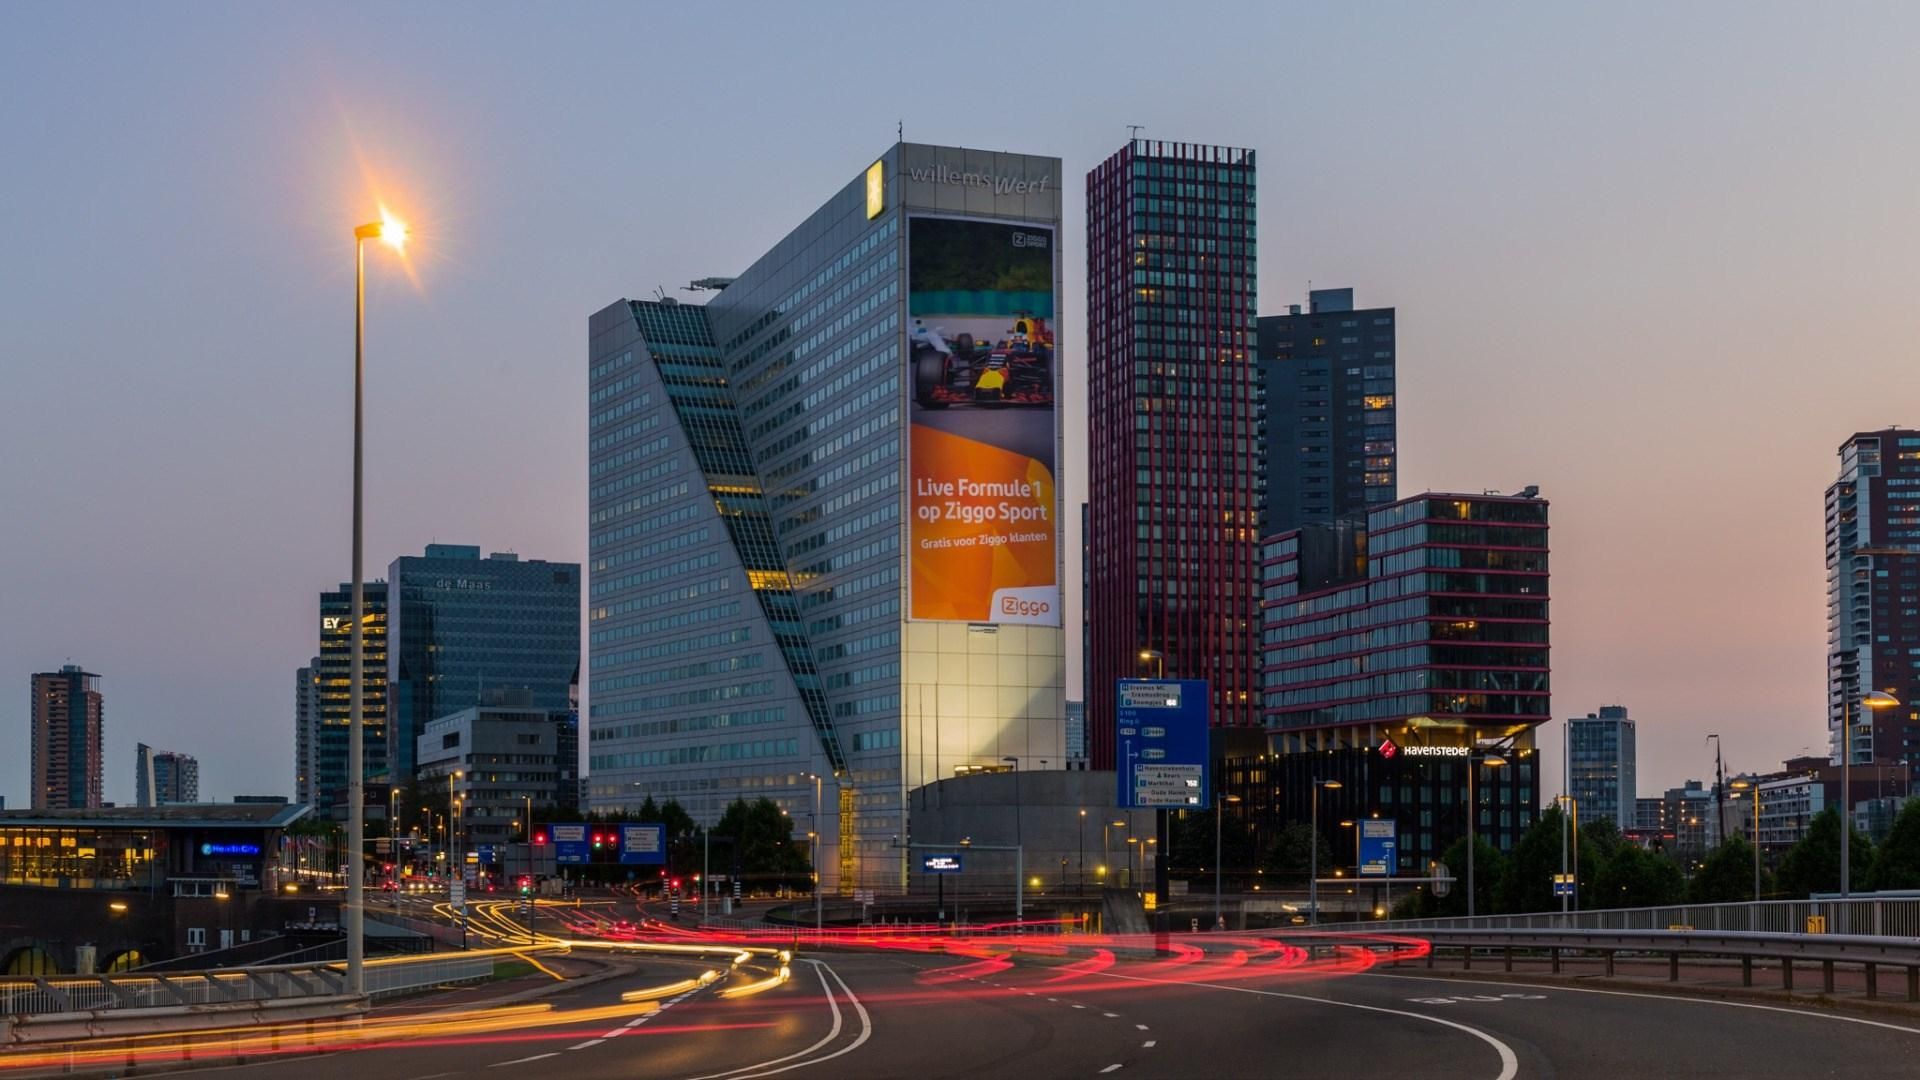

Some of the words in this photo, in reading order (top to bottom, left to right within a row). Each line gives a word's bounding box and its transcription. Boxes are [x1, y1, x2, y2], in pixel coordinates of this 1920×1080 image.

[917, 478, 954, 496] Live
[958, 479, 1031, 497] Formule
[1033, 480, 1041, 496] 1
[918, 505, 941, 523] op
[945, 502, 996, 523] Ziggo
[999, 503, 1047, 523] Sport
[921, 538, 951, 549] Gratis
[953, 537, 977, 546] voor
[979, 534, 1007, 546] Ziggo
[1009, 532, 1047, 543] klanten
[323, 617, 340, 629] EY
